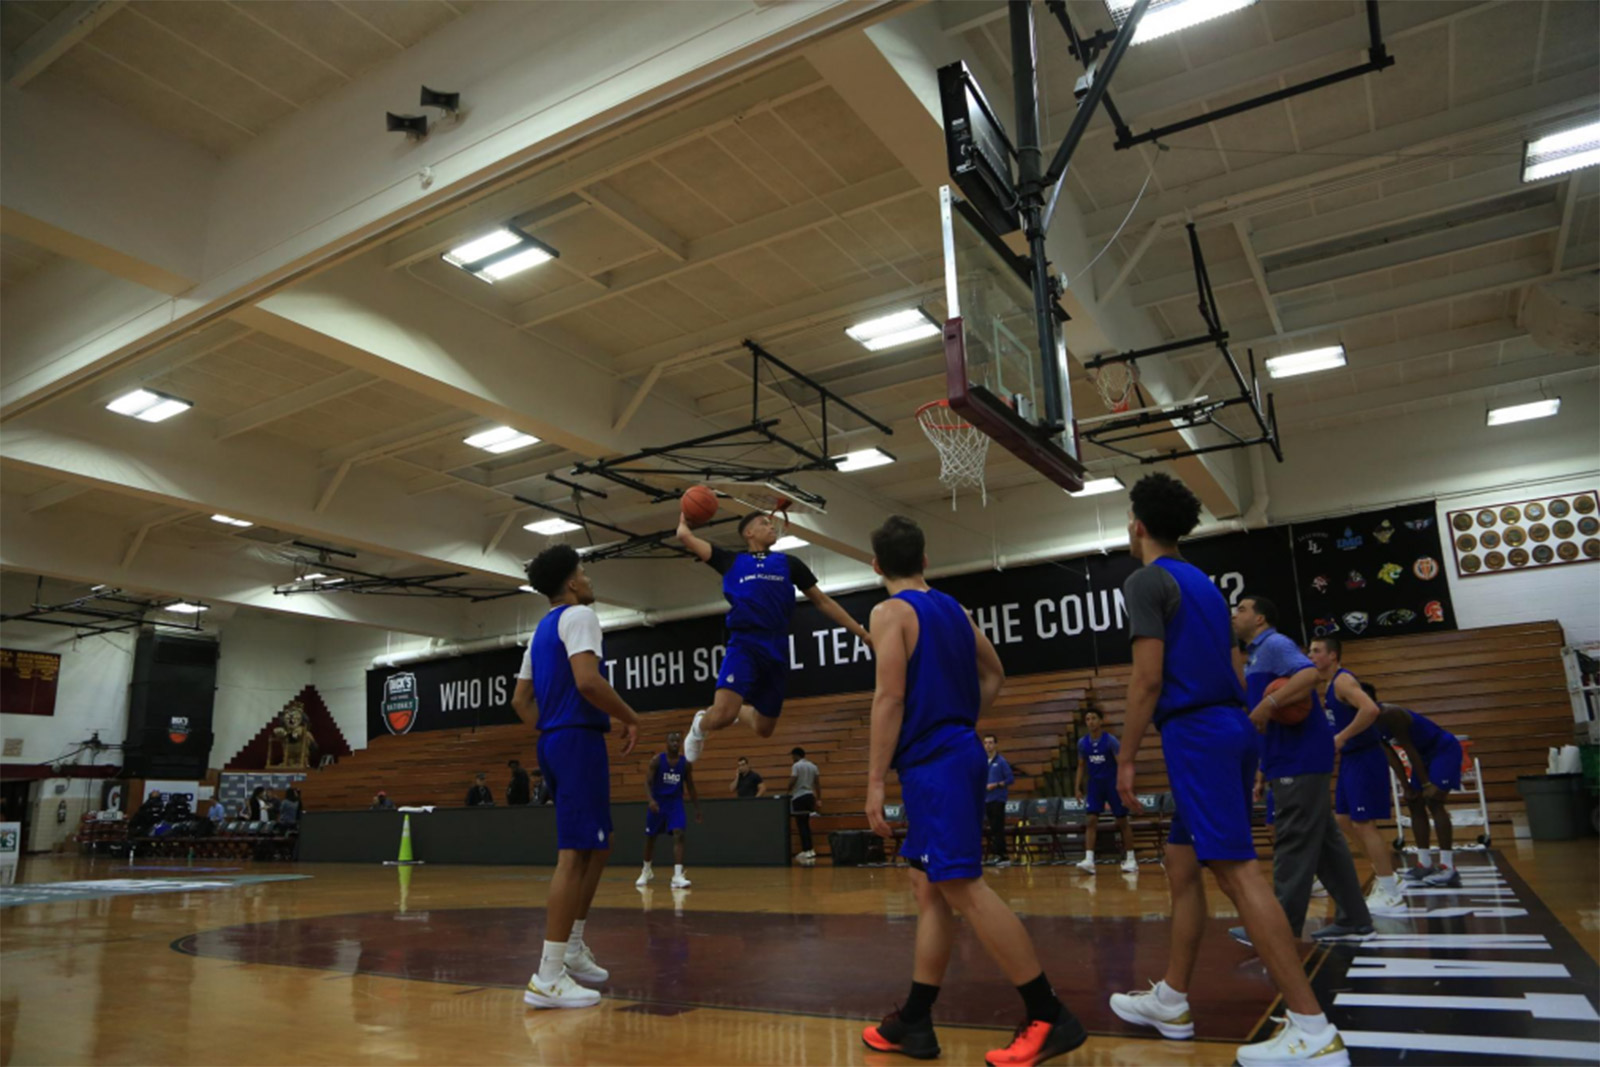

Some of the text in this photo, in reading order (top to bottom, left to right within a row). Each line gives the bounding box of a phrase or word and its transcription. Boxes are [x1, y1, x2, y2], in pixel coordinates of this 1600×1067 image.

[440, 678, 481, 712] WHO
[488, 675, 507, 707] IS
[626, 650, 684, 690] HIGH
[812, 625, 872, 667] TEA
[968, 602, 1023, 645] HE
